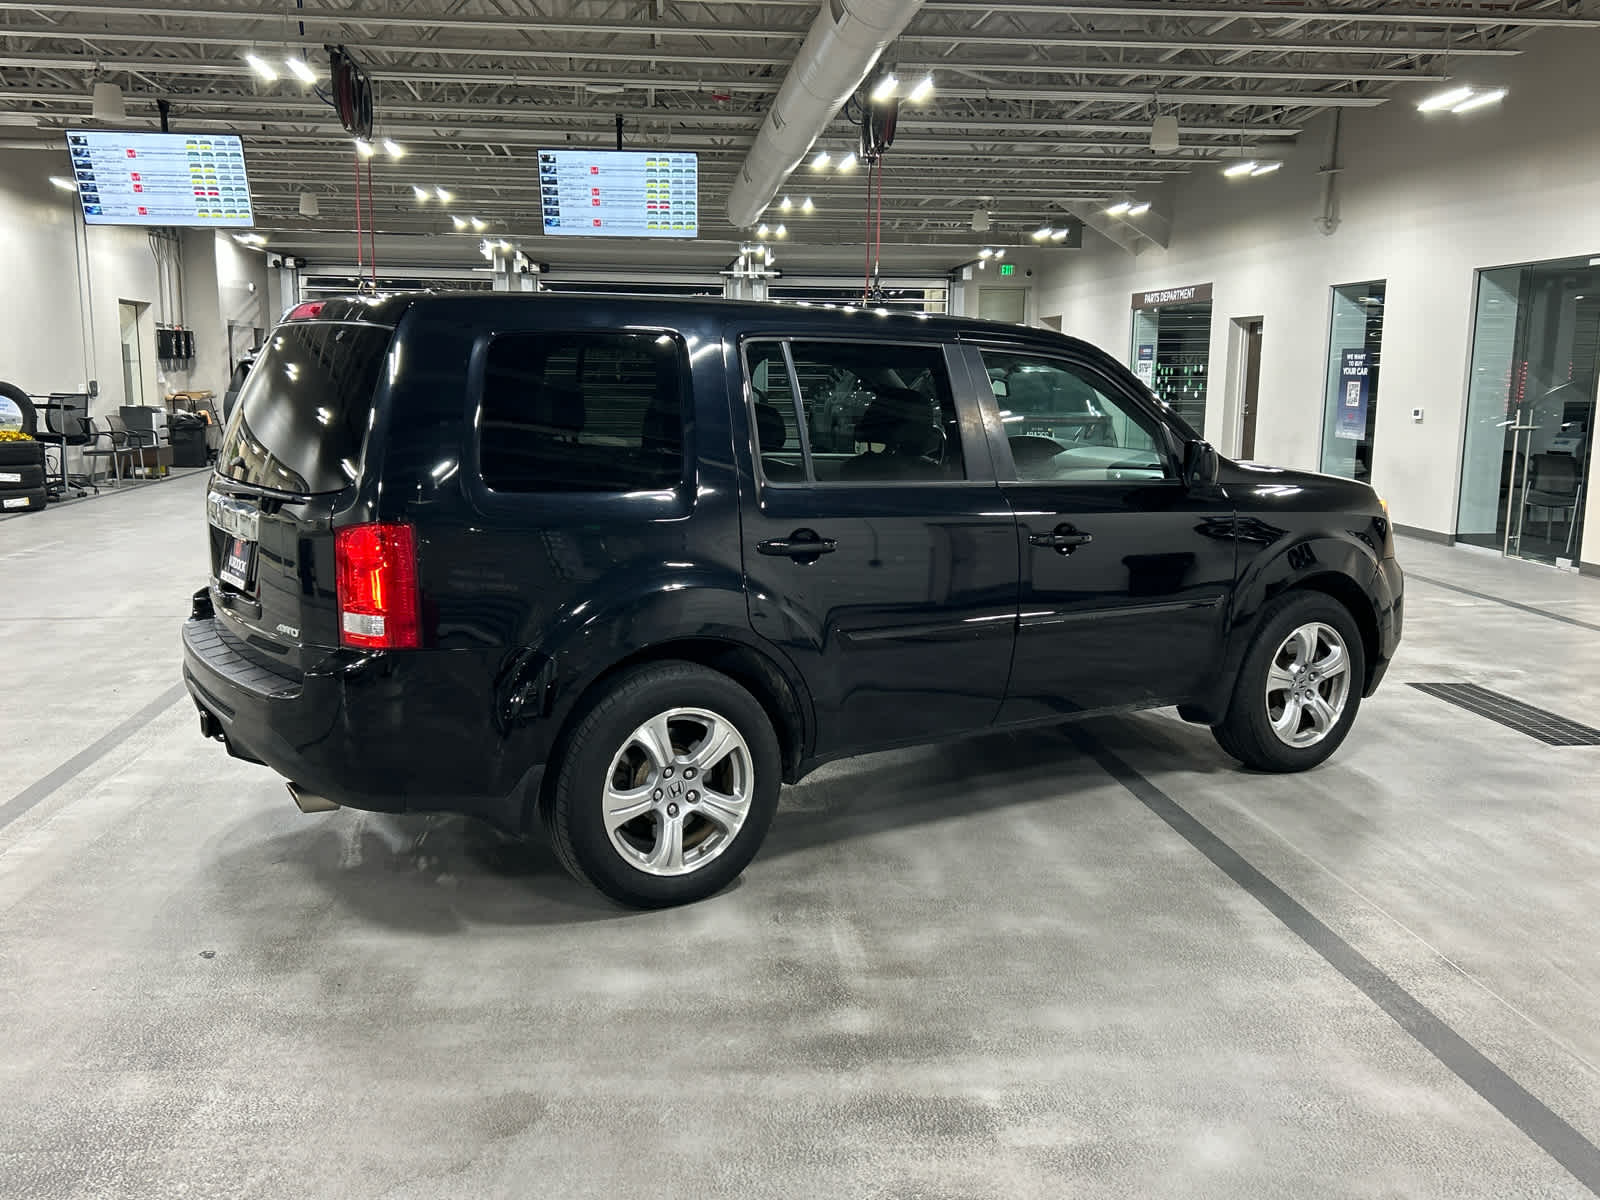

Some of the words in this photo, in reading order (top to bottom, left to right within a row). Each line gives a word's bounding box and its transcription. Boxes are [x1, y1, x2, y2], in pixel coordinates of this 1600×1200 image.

[1001, 264, 1014, 275] EXIT
[1144, 293, 1160, 304] PARTS
[1160, 288, 1195, 302] DEPARTMENT
[1343, 367, 1356, 376] YOUR
[1356, 367, 1368, 376] CAR
